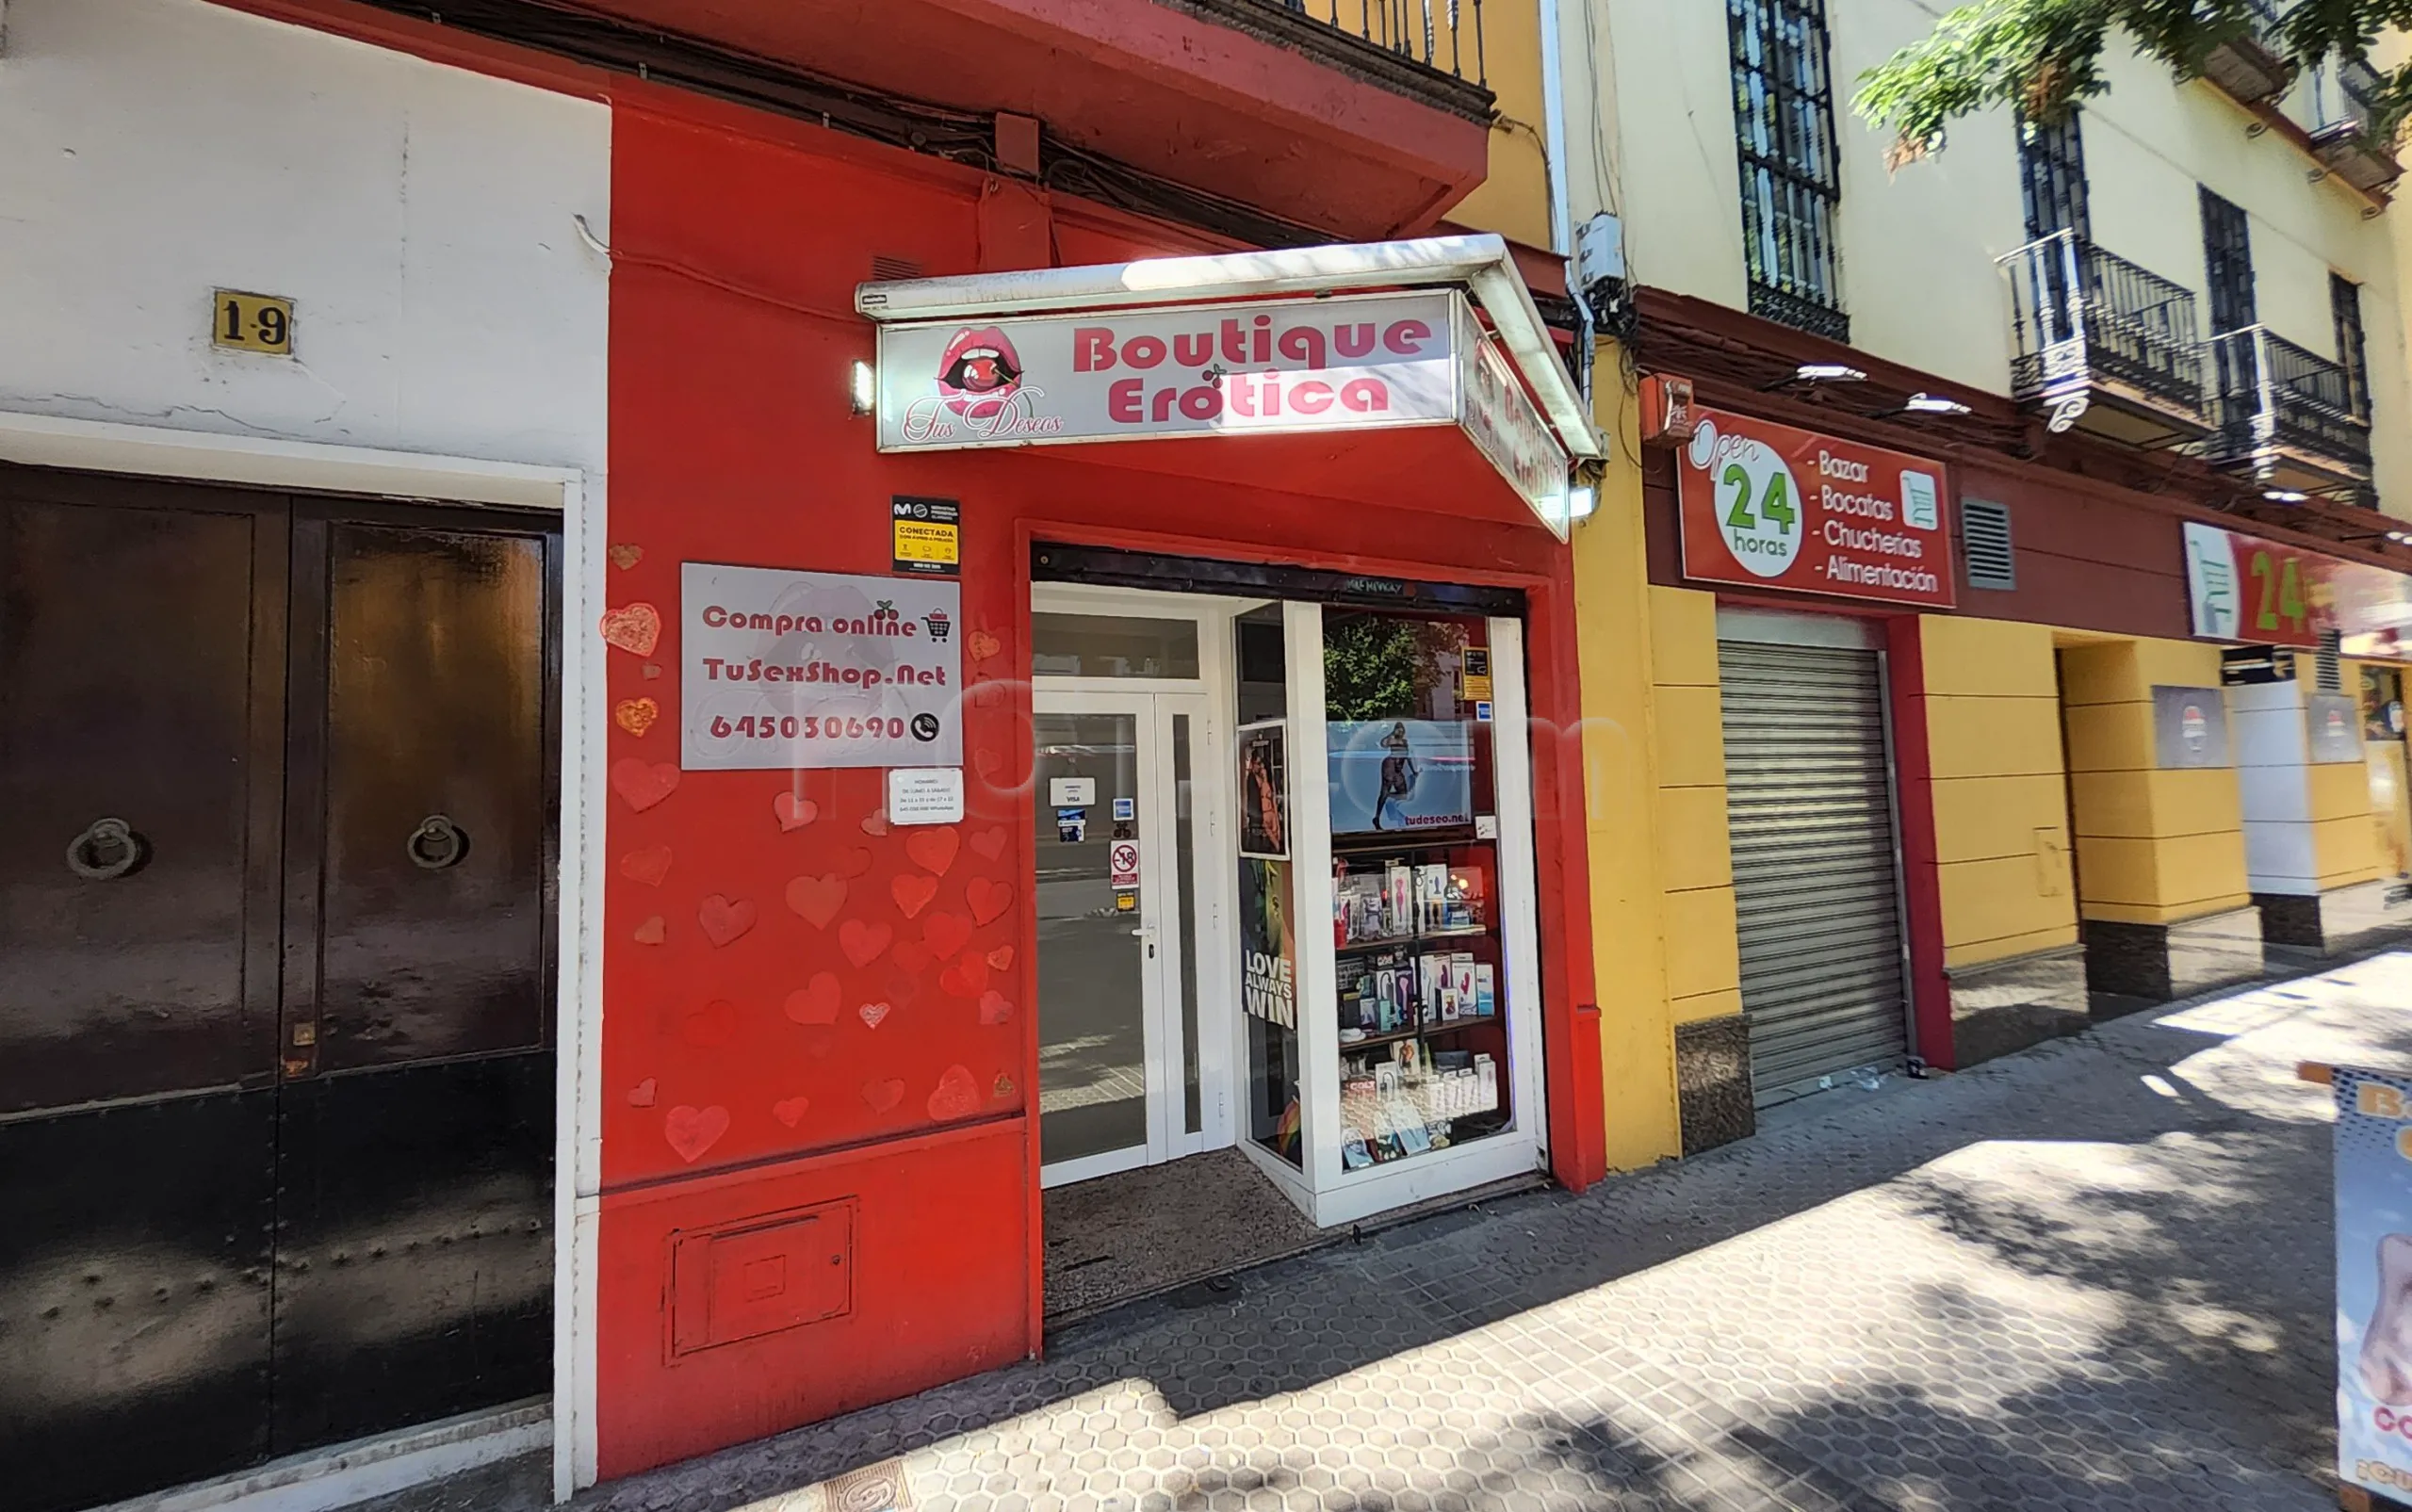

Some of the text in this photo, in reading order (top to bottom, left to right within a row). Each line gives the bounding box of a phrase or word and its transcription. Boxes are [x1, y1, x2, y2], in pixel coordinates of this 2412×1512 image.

[1073, 315, 1432, 374] Boutique
[903, 385, 1064, 443] Tus Deseos
[1688, 419, 1760, 481] Open
[1722, 463, 1795, 535] 24
[899, 527, 953, 538] CONECTADA
[1733, 528, 1787, 557] horas
[2250, 550, 2306, 634] 24
[703, 606, 917, 638] Compra online
[703, 658, 946, 690] TuSexShop.Net
[710, 715, 904, 740] 645030690
[1246, 949, 1292, 983] LOVE
[1245, 971, 1292, 999] ALWAYS
[1245, 985, 1294, 1030] WIN
